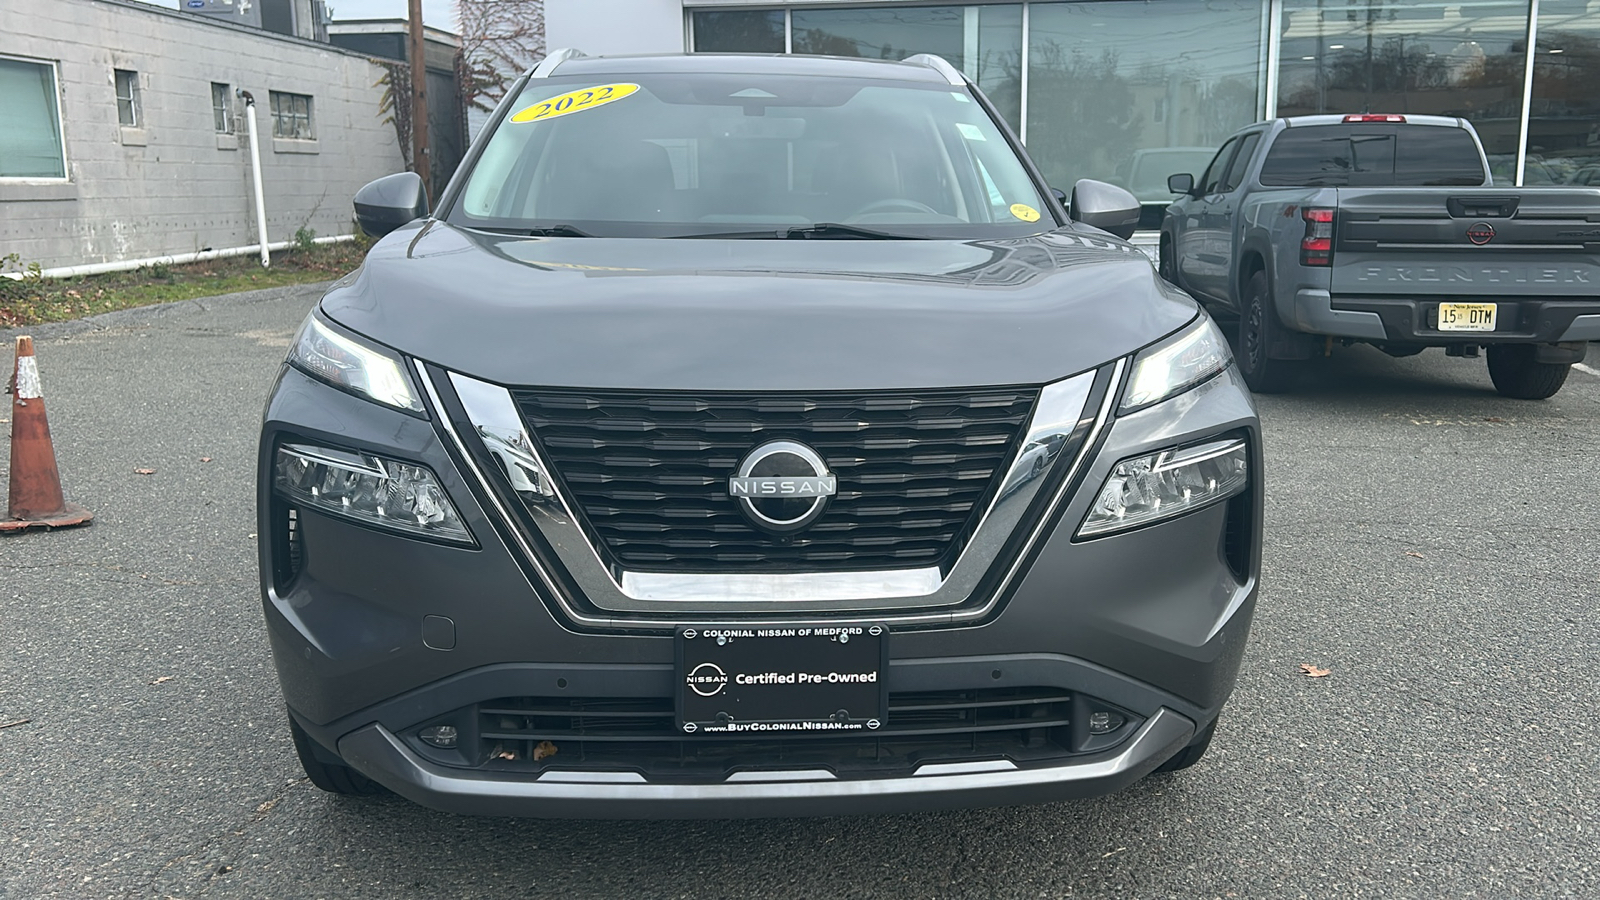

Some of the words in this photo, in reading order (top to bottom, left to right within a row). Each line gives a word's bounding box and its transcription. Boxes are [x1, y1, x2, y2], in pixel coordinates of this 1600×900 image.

[533, 87, 614, 119] 2022
[1358, 267, 1590, 283] FRONTIER
[1442, 309, 1456, 323] 15
[1470, 309, 1492, 324] DTM
[733, 480, 833, 494] NISSAN
[757, 629, 796, 637] NISSAN
[814, 627, 863, 636] MEDFORD
[735, 672, 795, 684] Certified
[798, 671, 877, 684] Pre-Owned
